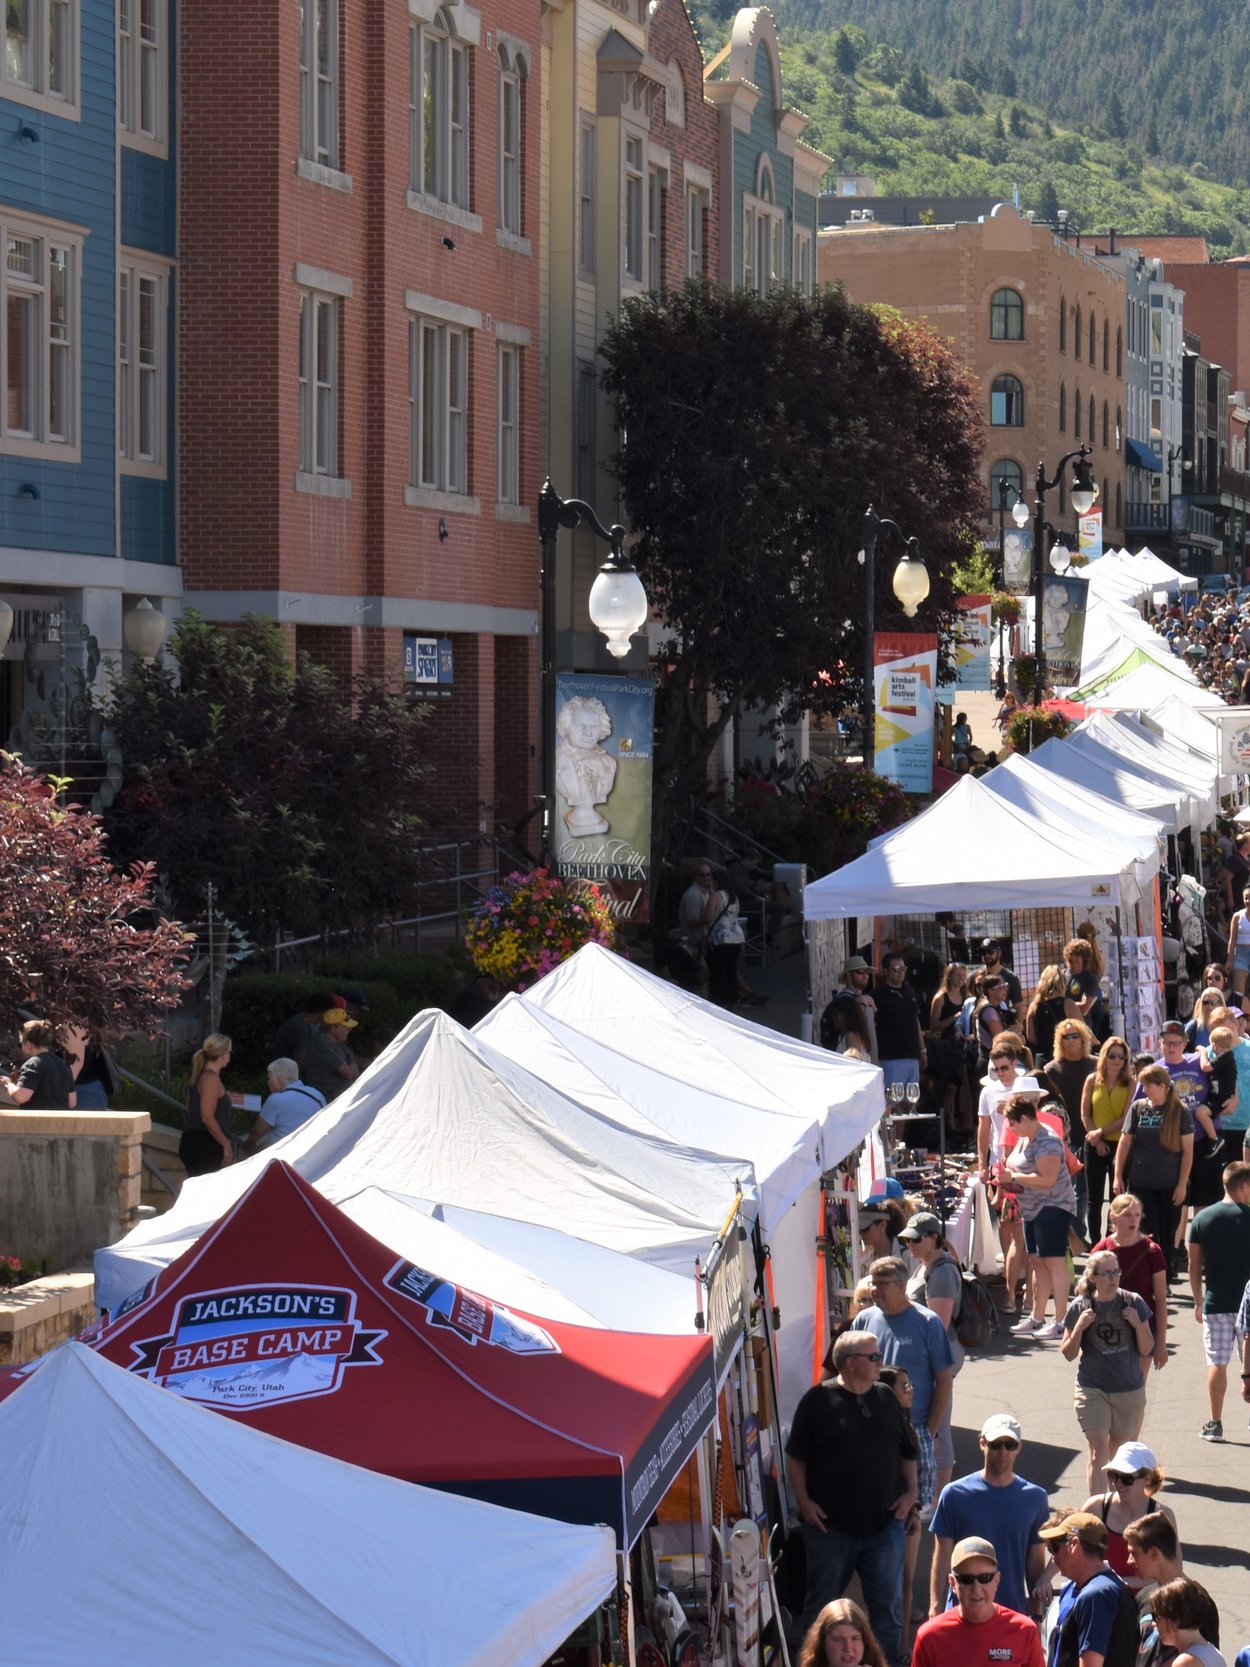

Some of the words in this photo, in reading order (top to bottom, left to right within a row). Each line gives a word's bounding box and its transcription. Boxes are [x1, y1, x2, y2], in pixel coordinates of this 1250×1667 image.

[892, 676, 916, 684] kimball
[558, 839, 606, 863] Park
[606, 838, 646, 875] City
[558, 863, 647, 880] BEETHOVEN
[190, 1294, 336, 1321] JACKSON'S
[170, 1337, 249, 1370] BASE
[257, 1329, 342, 1356] CAMP
[212, 1385, 236, 1393] Park
[262, 1383, 285, 1391] Utah
[989, 1648, 1012, 1656] MORE
